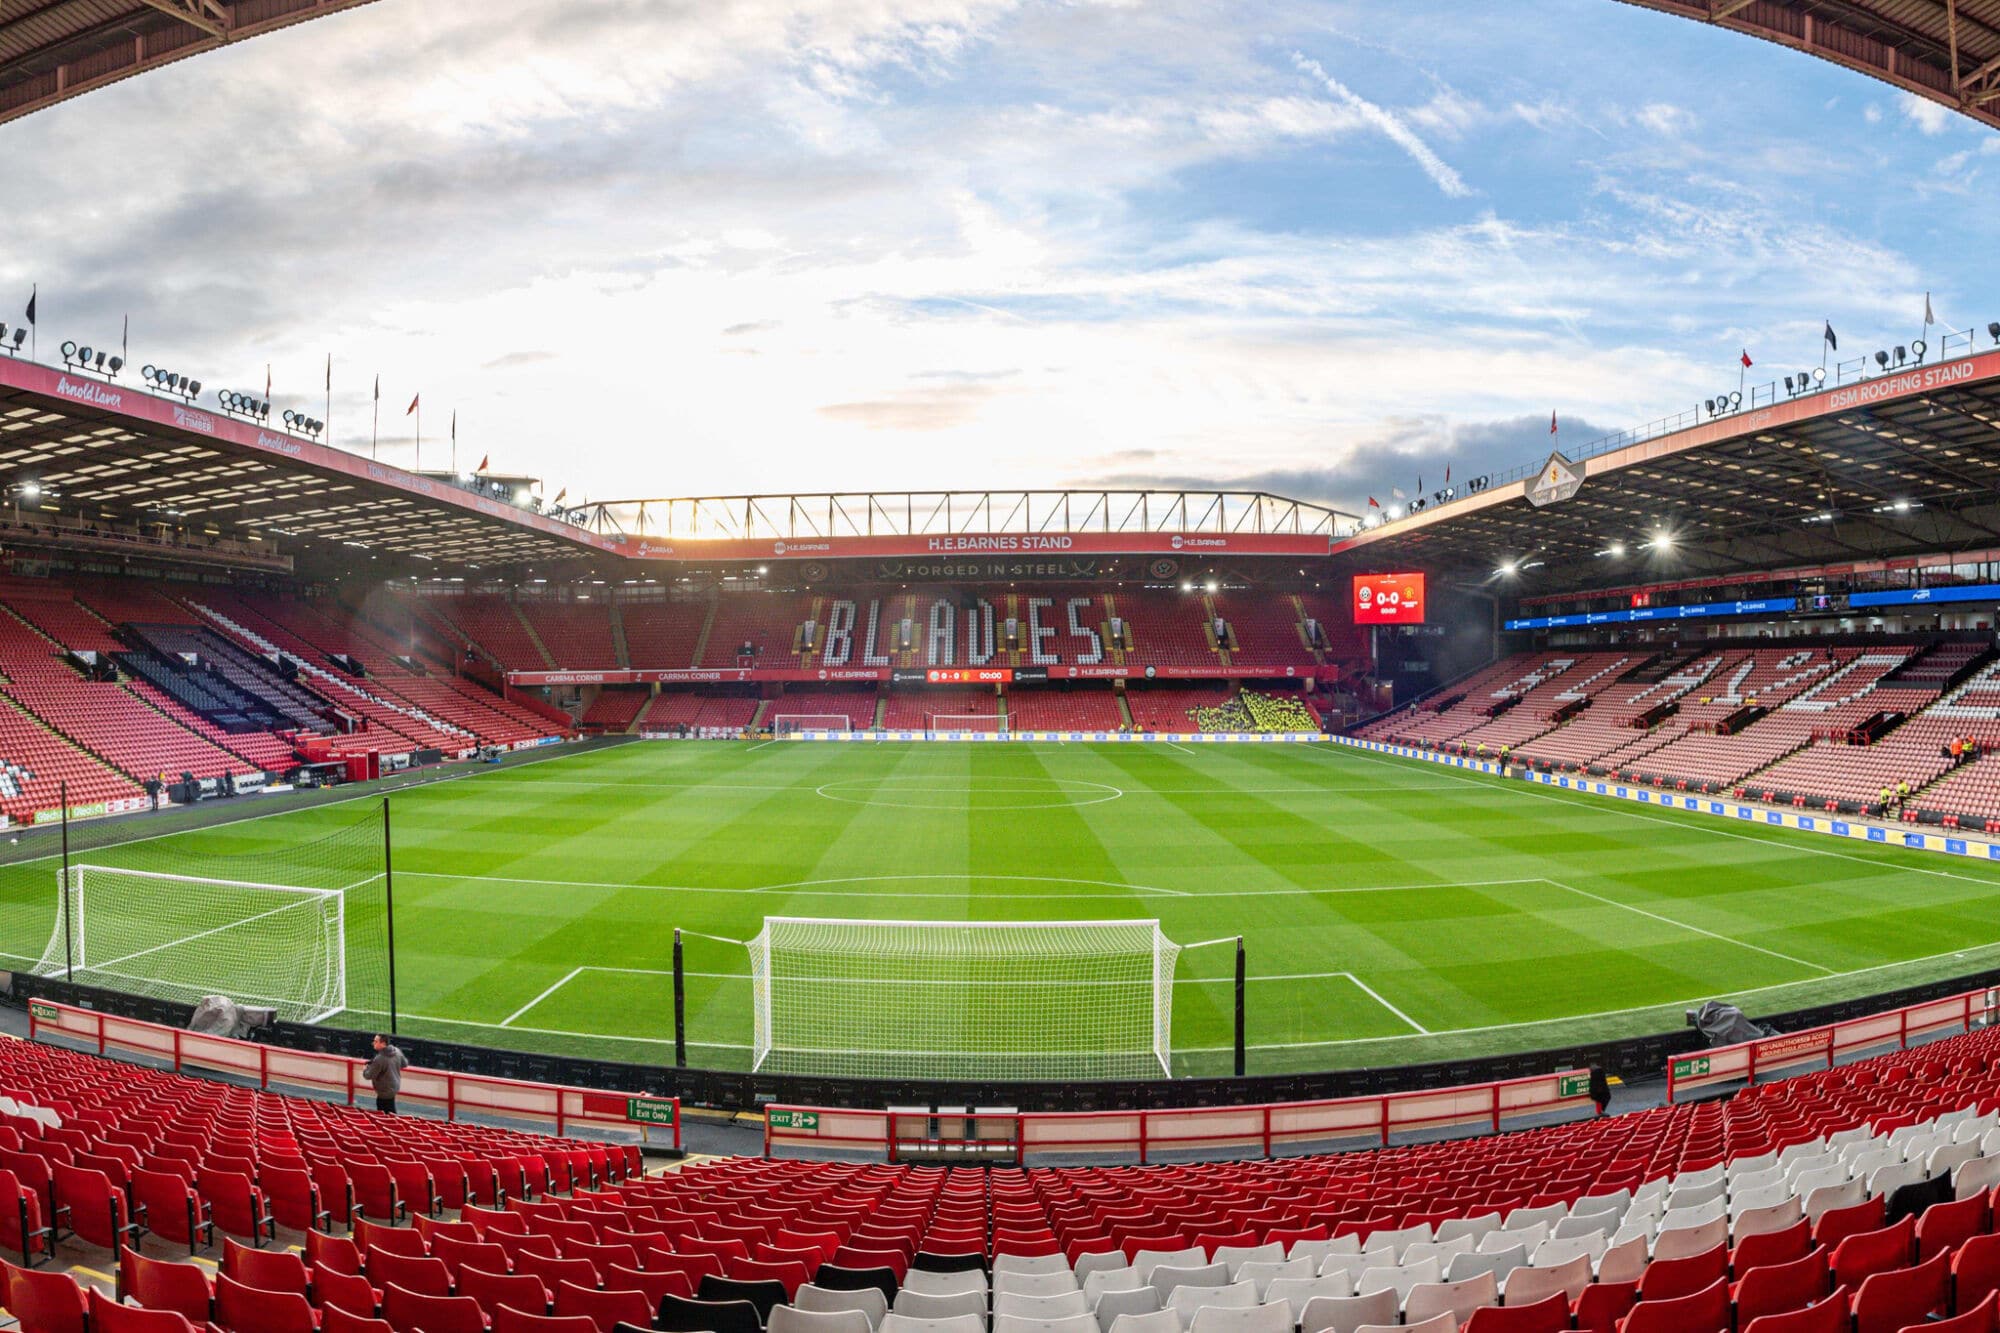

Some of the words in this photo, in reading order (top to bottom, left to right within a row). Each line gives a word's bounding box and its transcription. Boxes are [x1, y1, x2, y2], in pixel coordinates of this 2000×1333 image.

[1830, 391, 1857, 408] DSM
[1861, 373, 1921, 401] ROOFING
[1925, 362, 1974, 387] STAND
[57, 376, 94, 401] Arnold
[95, 386, 121, 407] Laver
[929, 536, 1018, 550] H.E.BARNES
[1022, 536, 1072, 549] STAND
[907, 565, 979, 576] FORGED
[988, 564, 1004, 575] IN
[1013, 564, 1066, 575] STEEL
[823, 598, 1102, 666] BLADES
[576, 674, 603, 682] CORNER
[690, 672, 720, 680] CORNER
[1675, 1064, 1690, 1073] EXIT
[636, 1100, 672, 1112] Emergency
[636, 1109, 650, 1118] Exit
[652, 1111, 667, 1122] Only
[770, 1114, 790, 1123] EXIT
